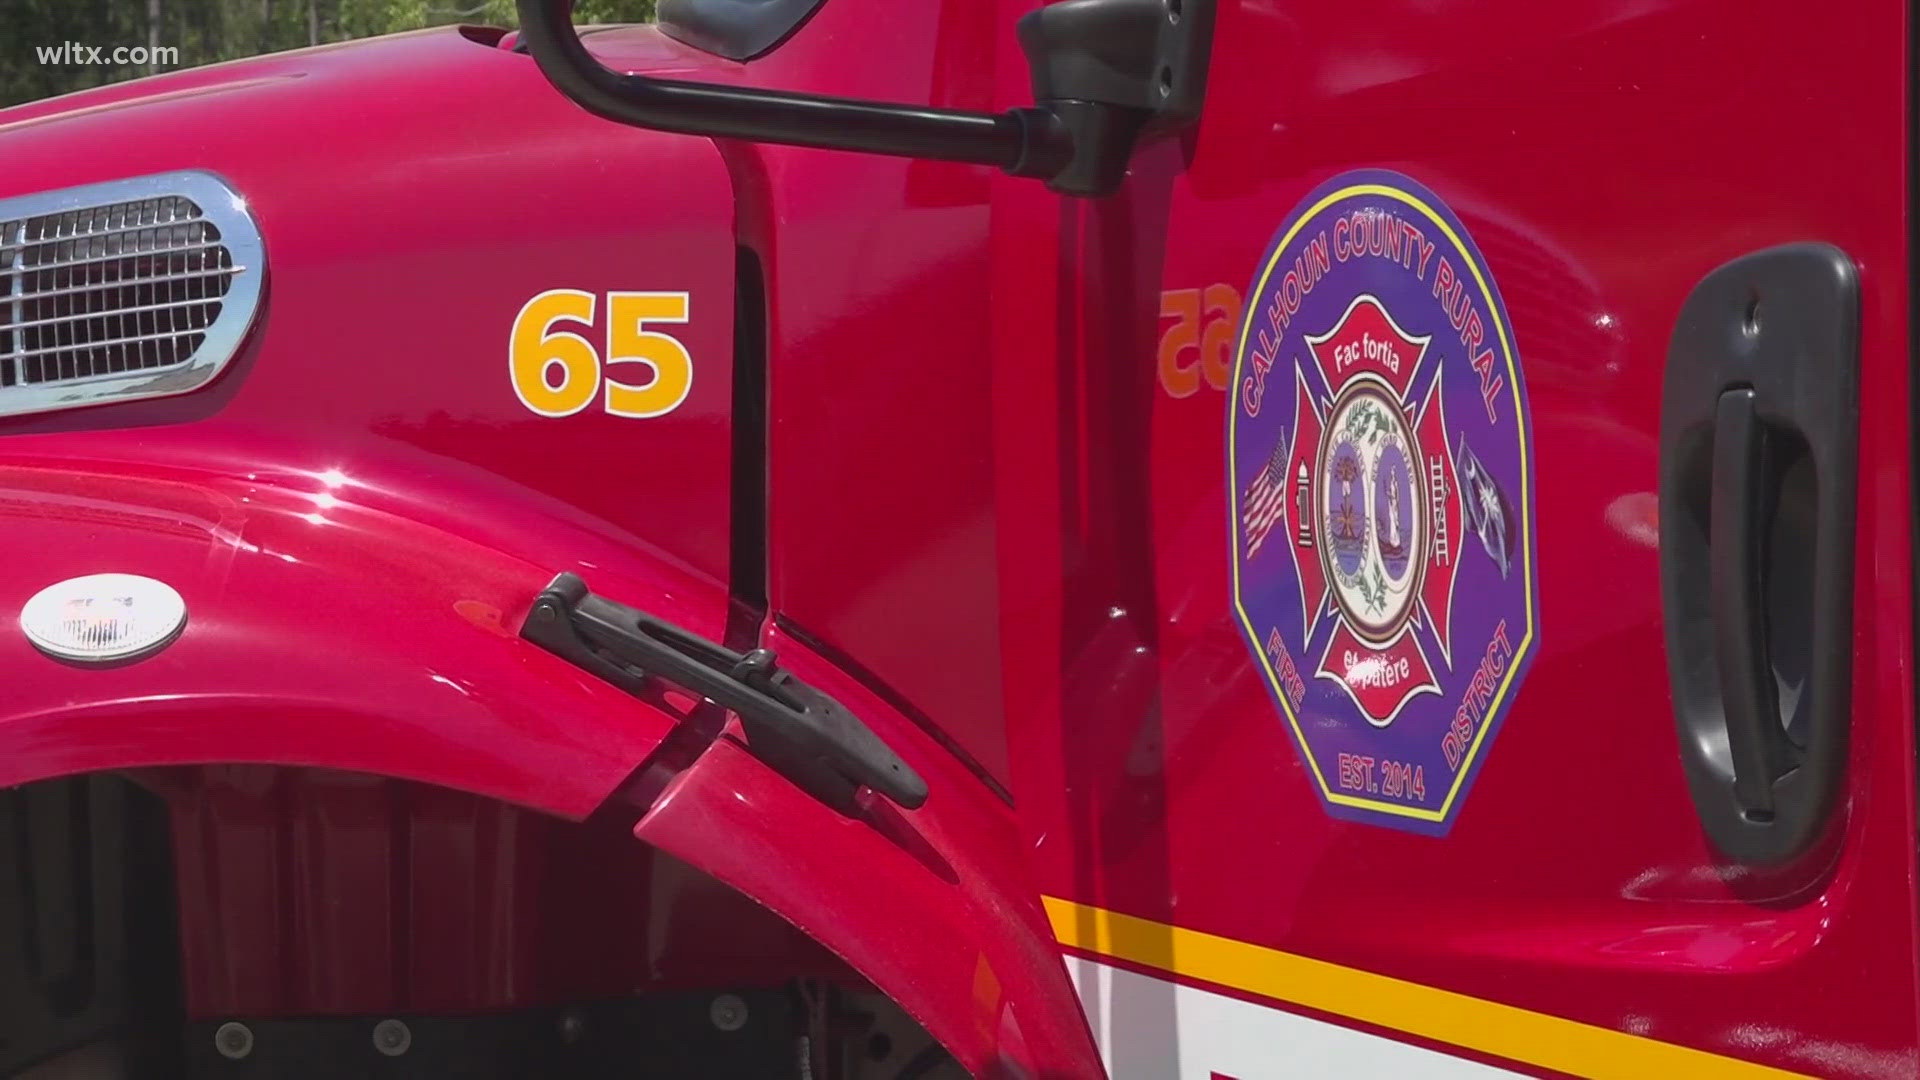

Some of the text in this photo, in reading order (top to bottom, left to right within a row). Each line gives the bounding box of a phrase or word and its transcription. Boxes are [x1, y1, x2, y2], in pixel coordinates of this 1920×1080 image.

[508, 288, 693, 419] 65
[1242, 214, 1504, 424] CALHOUN COUNTY RURAL
[1333, 332, 1401, 375] Fac fortia
[1266, 619, 1513, 772] FIRE DISTRICT
[1338, 752, 1426, 801] EST. 2014
